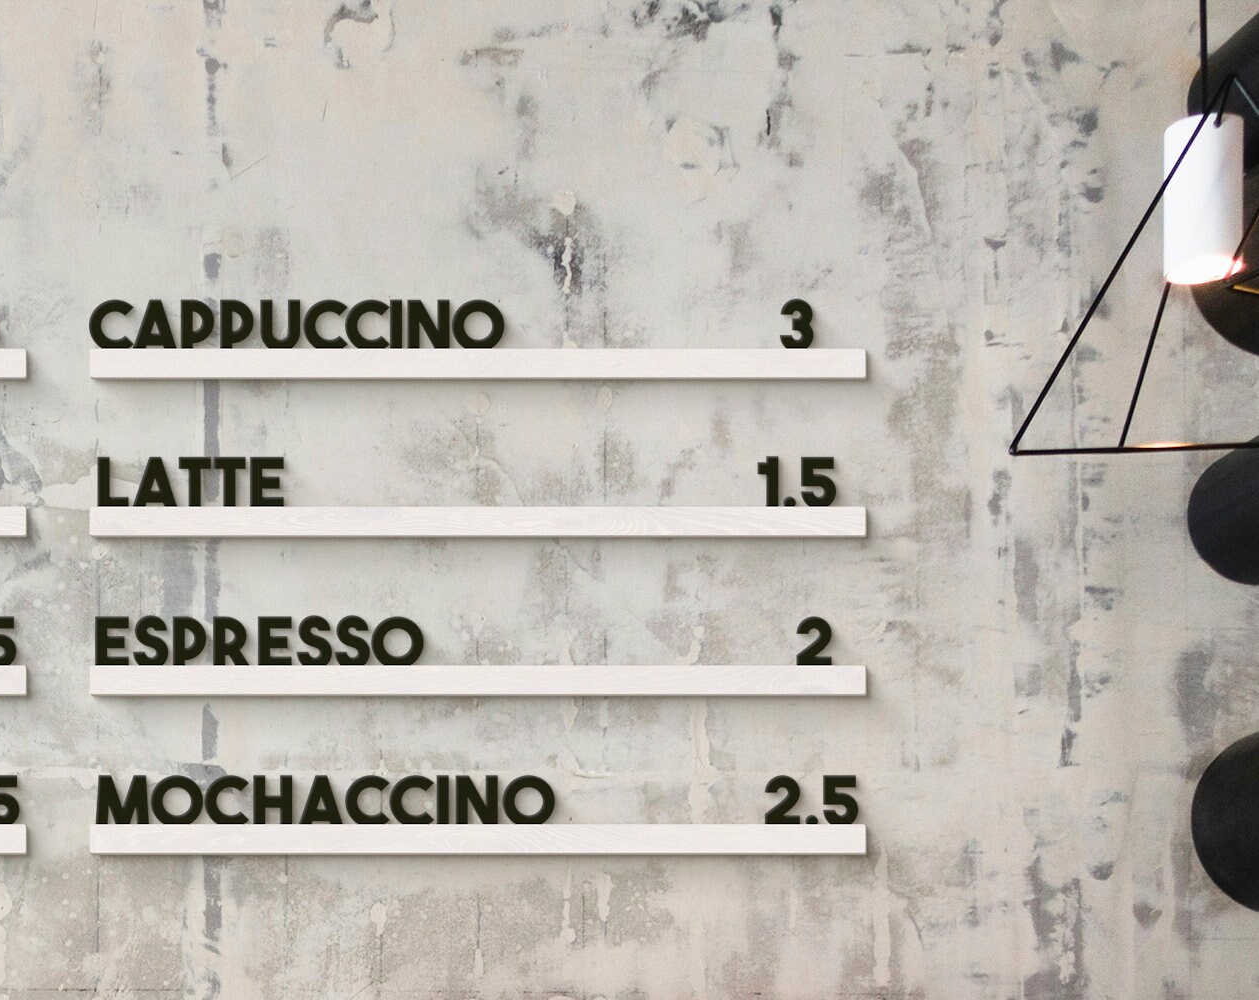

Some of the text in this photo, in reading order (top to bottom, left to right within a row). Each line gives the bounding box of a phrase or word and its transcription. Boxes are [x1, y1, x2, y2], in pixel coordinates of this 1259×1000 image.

[90, 299, 815, 349] CAPPUCCINO 3
[97, 457, 837, 507] LATTE 1.5
[95, 615, 833, 666] ESPRESSO 2
[96, 775, 859, 825] MOCHACCINO 2.5
